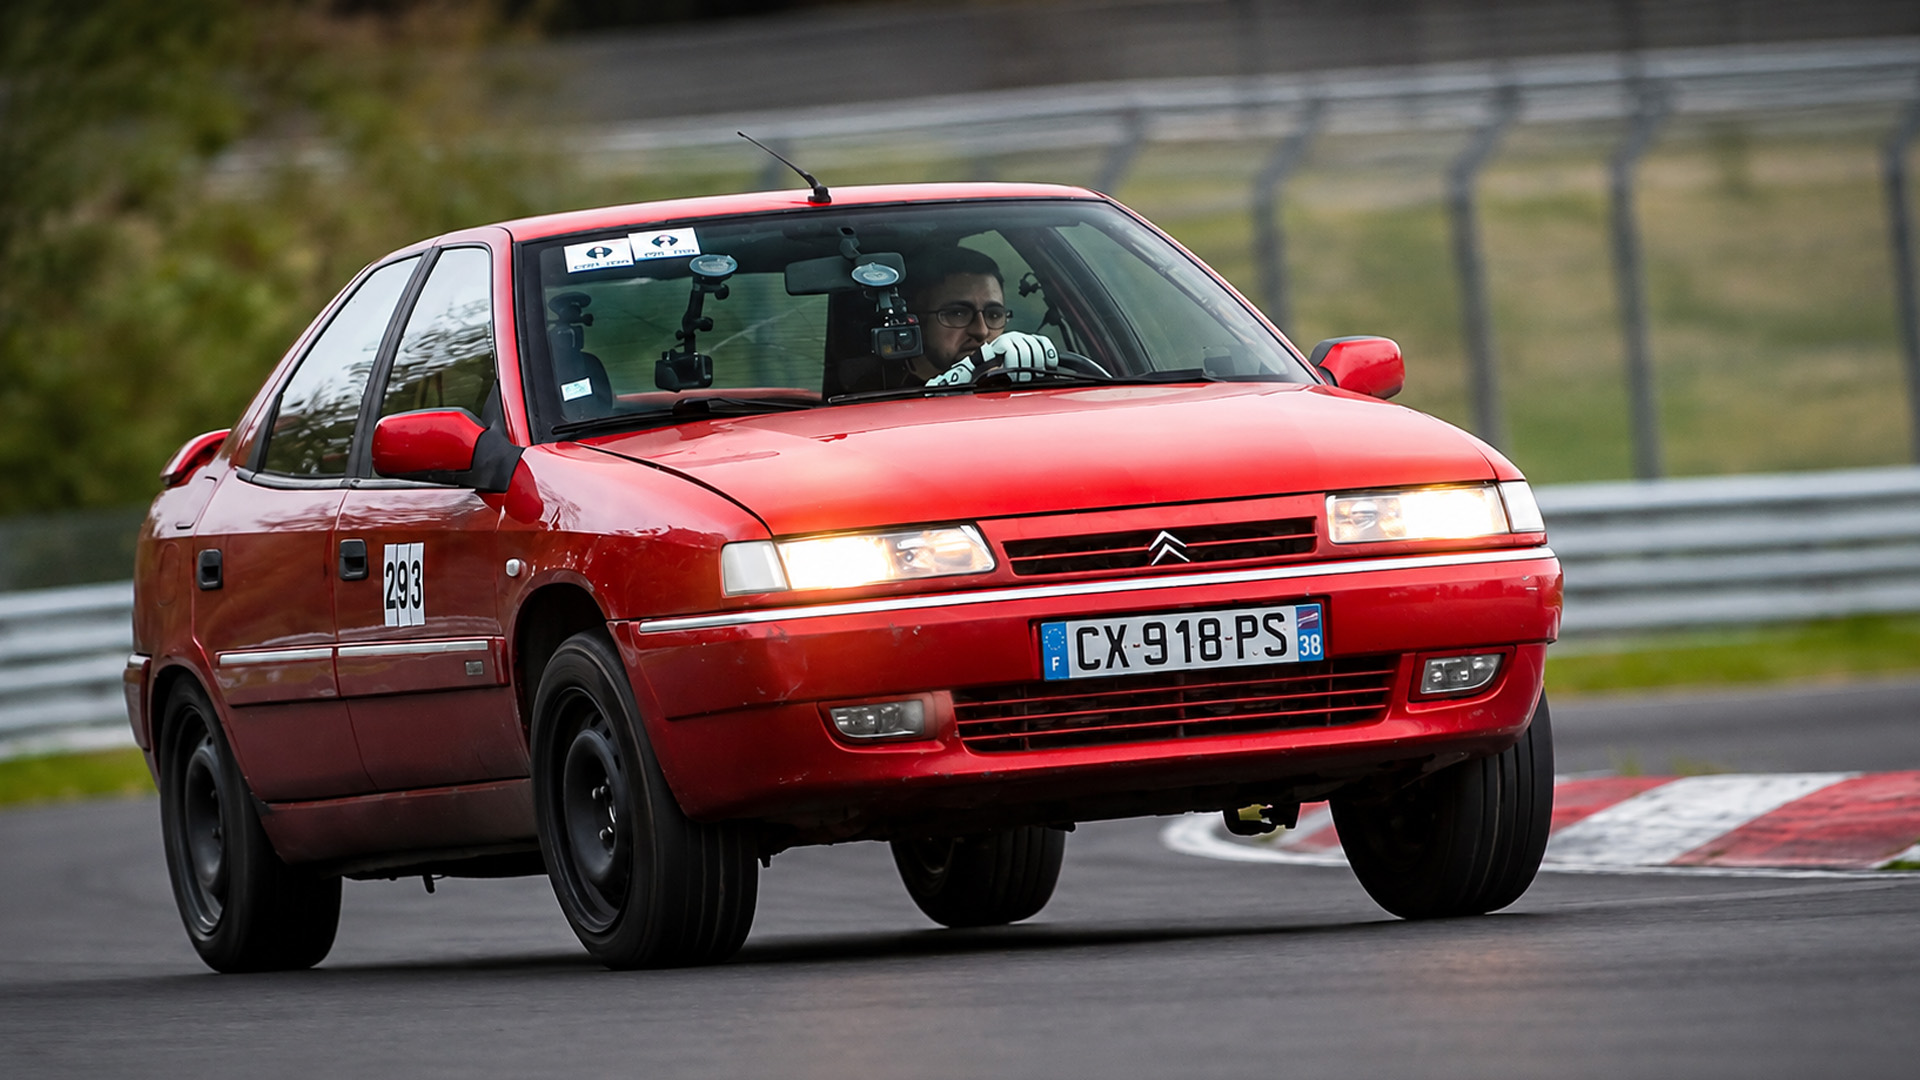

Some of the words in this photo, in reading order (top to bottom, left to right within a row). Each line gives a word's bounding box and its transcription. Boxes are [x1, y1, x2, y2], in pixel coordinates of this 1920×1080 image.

[386, 560, 421, 609] 293
[1300, 635, 1321, 656] 38
[1052, 657, 1060, 671] F
